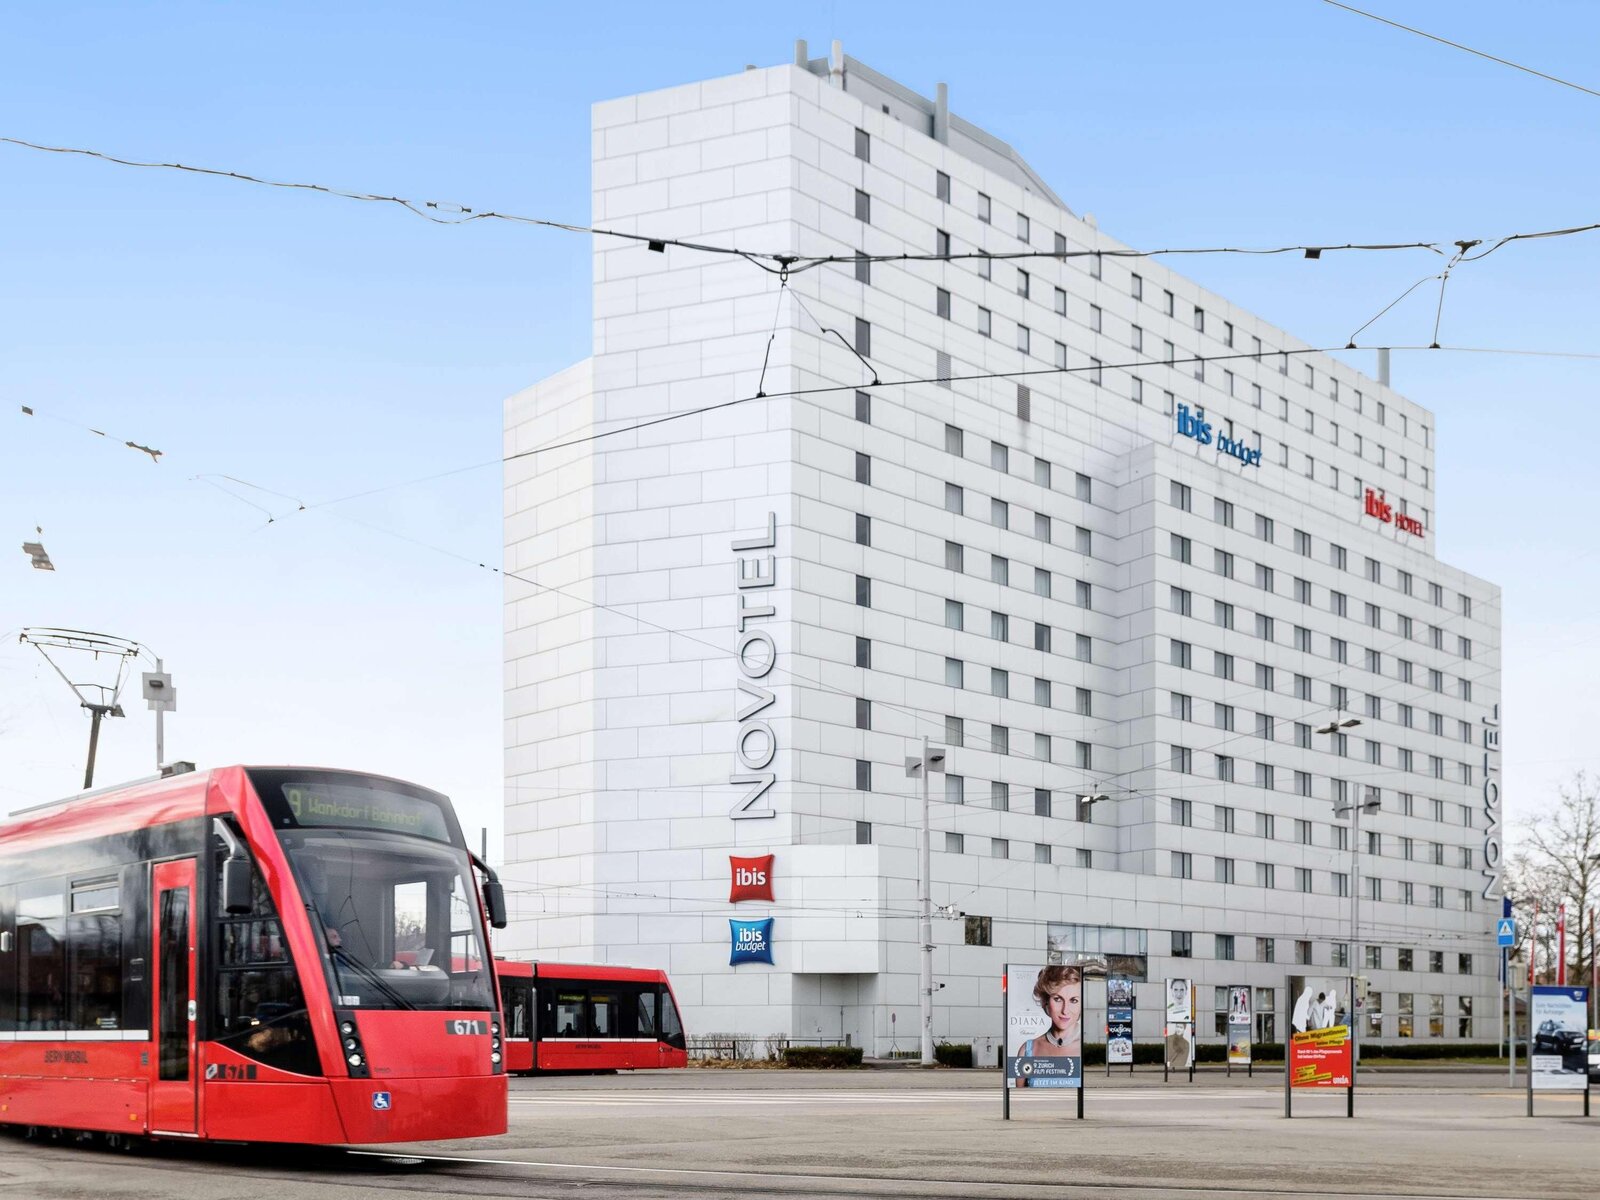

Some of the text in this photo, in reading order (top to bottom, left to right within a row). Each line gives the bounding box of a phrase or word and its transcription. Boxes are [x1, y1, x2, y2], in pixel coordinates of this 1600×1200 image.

[1177, 403, 1262, 467] ibis budget
[1365, 487, 1424, 537] ibis HOTEL
[729, 511, 776, 820] NOVOTEL
[288, 788, 301, 817] 9
[1482, 704, 1499, 901] NOVOTEL
[736, 868, 766, 886] ibis
[739, 928, 763, 942] ibis
[736, 941, 766, 953] budget
[454, 1020, 479, 1035] 671
[1010, 1017, 1045, 1025] DIANA
